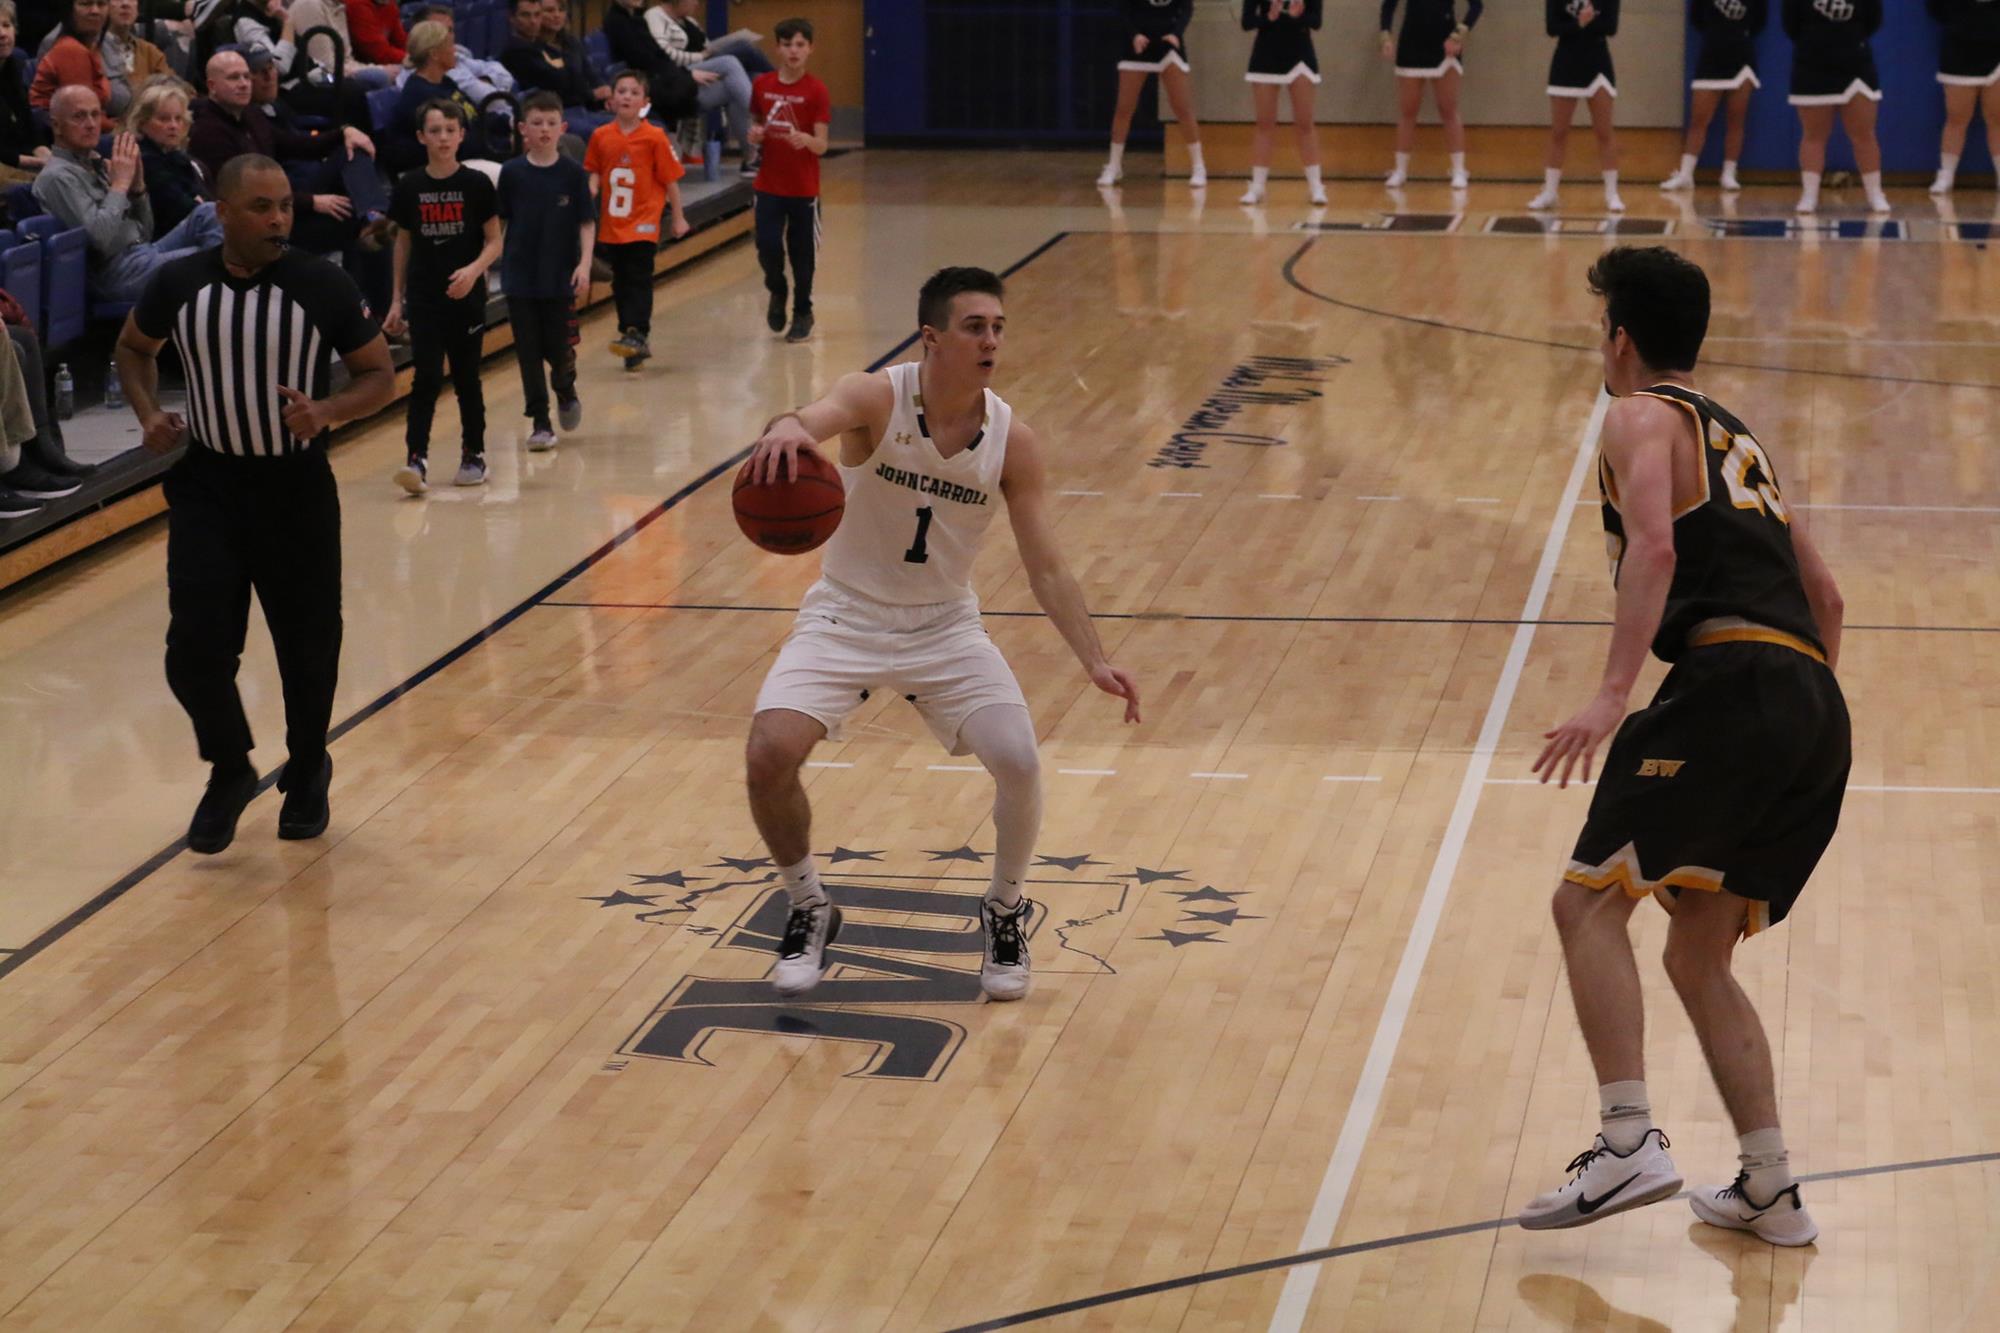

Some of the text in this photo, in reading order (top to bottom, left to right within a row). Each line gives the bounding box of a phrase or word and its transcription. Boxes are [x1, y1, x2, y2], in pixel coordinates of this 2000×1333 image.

[418, 191, 464, 203] YOU CALL
[608, 167, 636, 218] 6
[418, 202, 464, 222] THAT
[420, 221, 464, 237] GAME?
[903, 506, 933, 564] 1
[1635, 758, 1687, 777] BW
